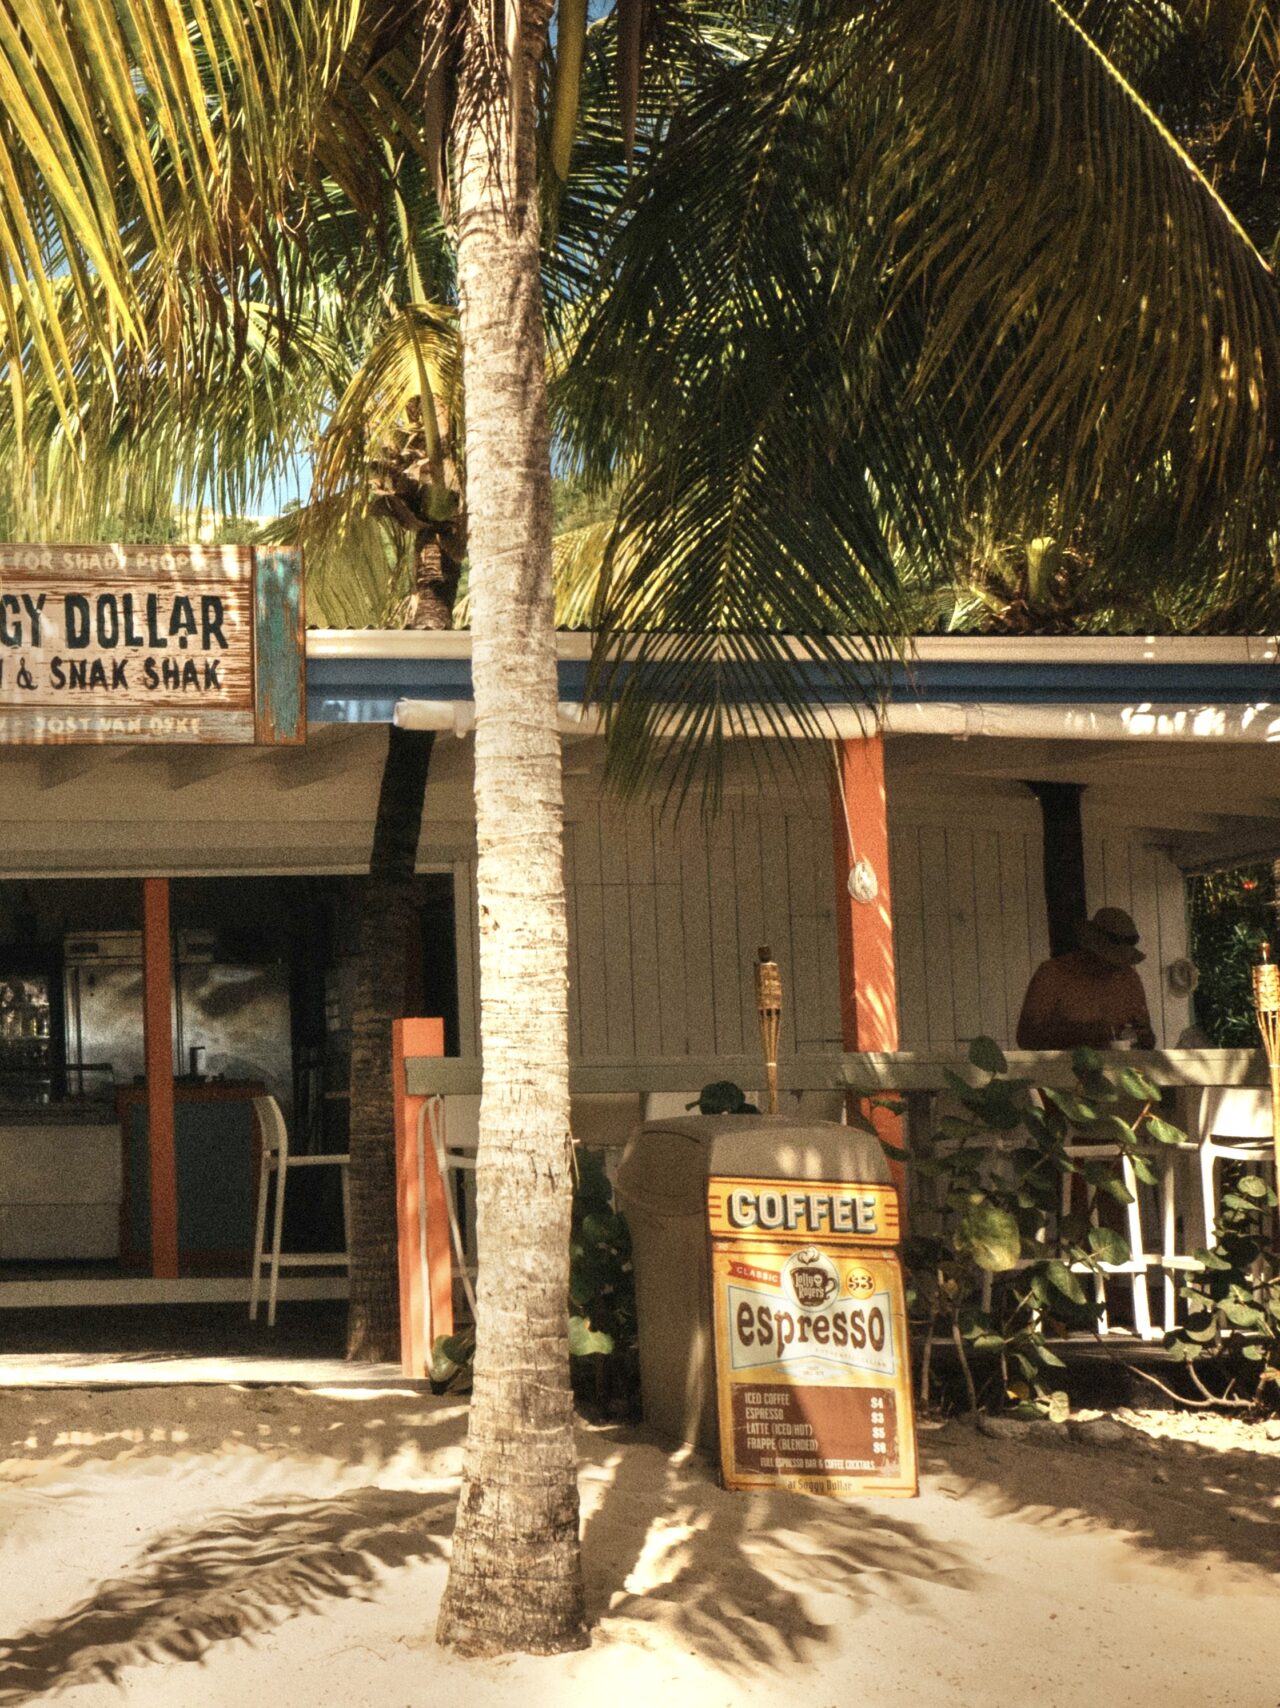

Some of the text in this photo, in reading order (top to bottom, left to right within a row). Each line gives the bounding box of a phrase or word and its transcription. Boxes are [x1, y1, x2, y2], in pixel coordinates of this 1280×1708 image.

[14, 551, 53, 570] FOR
[64, 593, 229, 650] DOLLAR
[17, 657, 38, 690] &
[50, 656, 129, 691] SNAK
[143, 656, 221, 692] SHAK
[728, 1188, 878, 1233] COFFEE
[736, 1266, 779, 1284] CLASSIC
[736, 1301, 885, 1358] espresso
[744, 1392, 762, 1405] ICED
[763, 1393, 790, 1407] COFFEE
[745, 1407, 784, 1421] ESPRESSO
[746, 1422, 769, 1435] LATTE
[747, 1437, 776, 1450] FRAPPE
